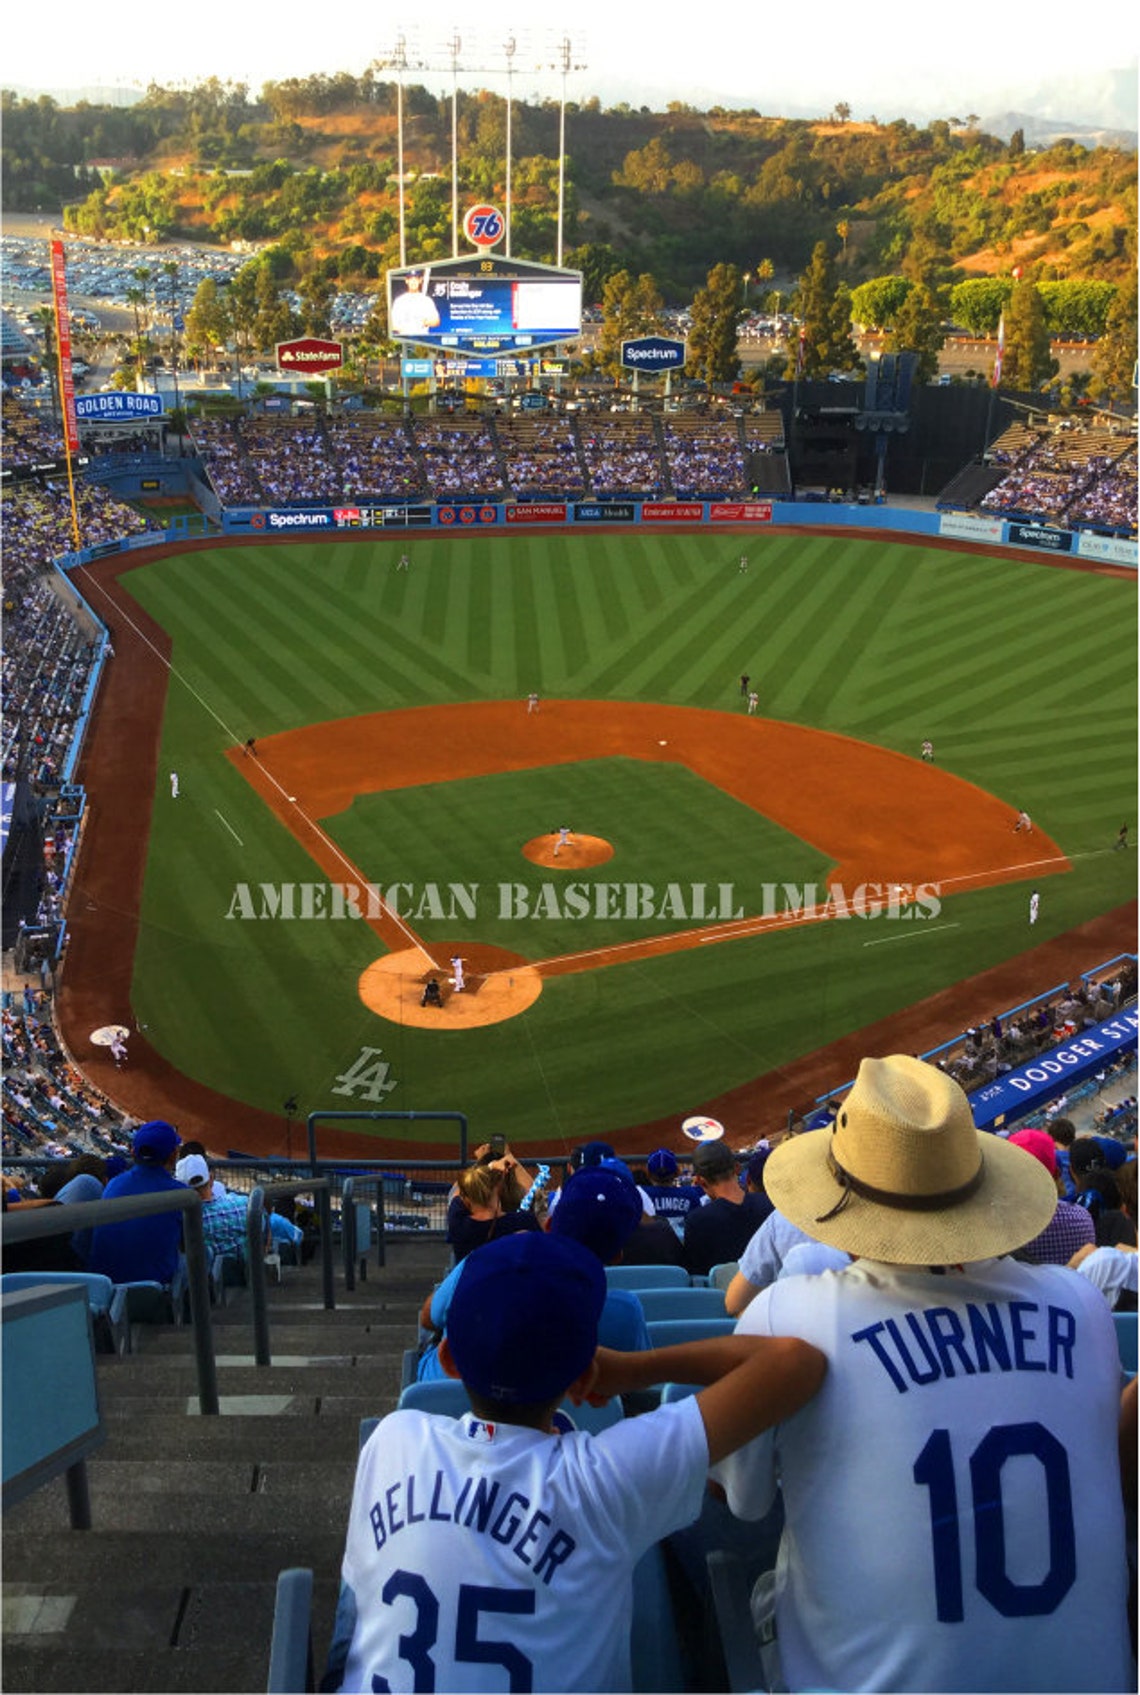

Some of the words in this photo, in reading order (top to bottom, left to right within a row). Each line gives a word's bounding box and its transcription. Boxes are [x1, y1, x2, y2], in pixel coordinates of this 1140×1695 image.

[473, 213, 499, 237] 76
[626, 347, 677, 361] Spectrum
[77, 396, 123, 415] GOLDEN
[126, 396, 159, 412] ROAD
[269, 513, 328, 528] Spectrum
[1019, 527, 1060, 541] Spectrum
[1009, 1038, 1105, 1091] DODGER
[1100, 1010, 1138, 1039] STA
[331, 1046, 398, 1103] LA
[655, 1196, 690, 1212] LINGER
[852, 1301, 1076, 1393] TURNER
[369, 1470, 576, 1585] BELLINGER
[913, 1421, 1077, 1623] 10
[371, 1568, 536, 1694] 35
